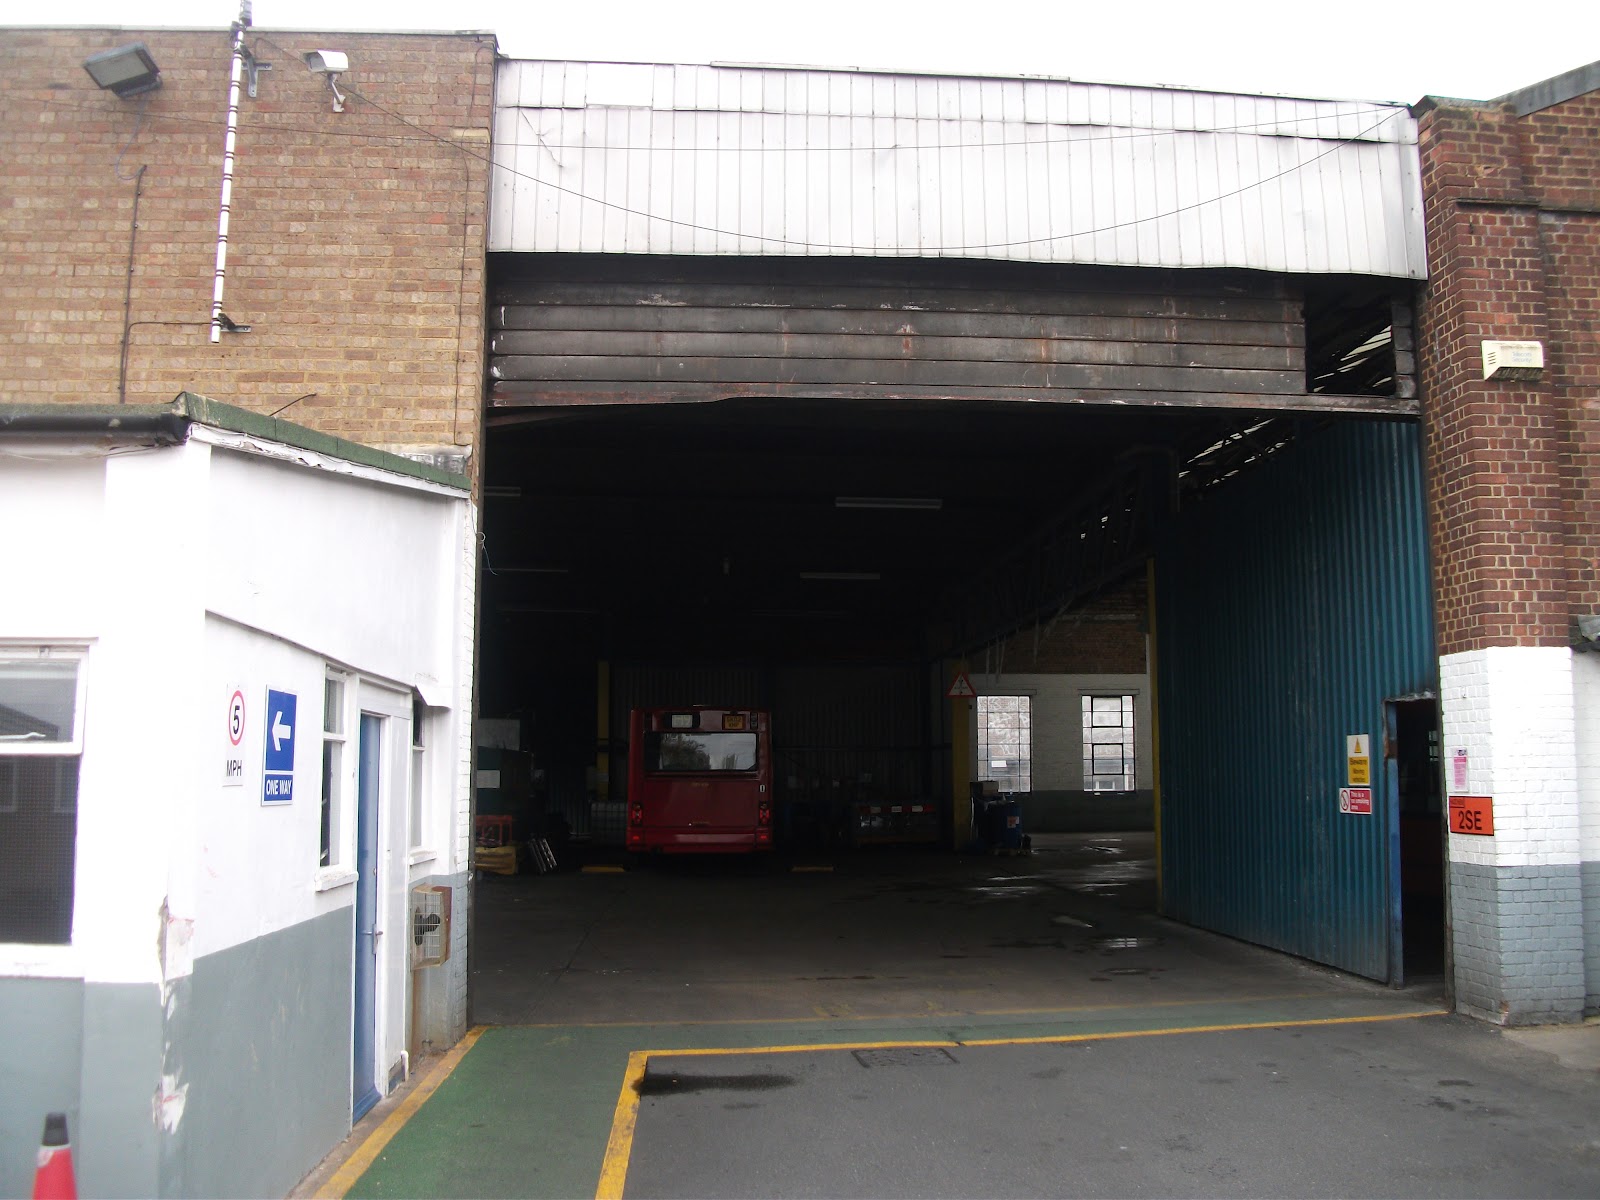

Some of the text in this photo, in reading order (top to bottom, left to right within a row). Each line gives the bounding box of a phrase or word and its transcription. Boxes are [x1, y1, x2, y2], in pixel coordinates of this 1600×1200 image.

[232, 705, 240, 735] 5
[226, 759, 242, 777] MPH
[266, 779, 292, 795] ONE WAY
[1458, 809, 1483, 831] 2SE
